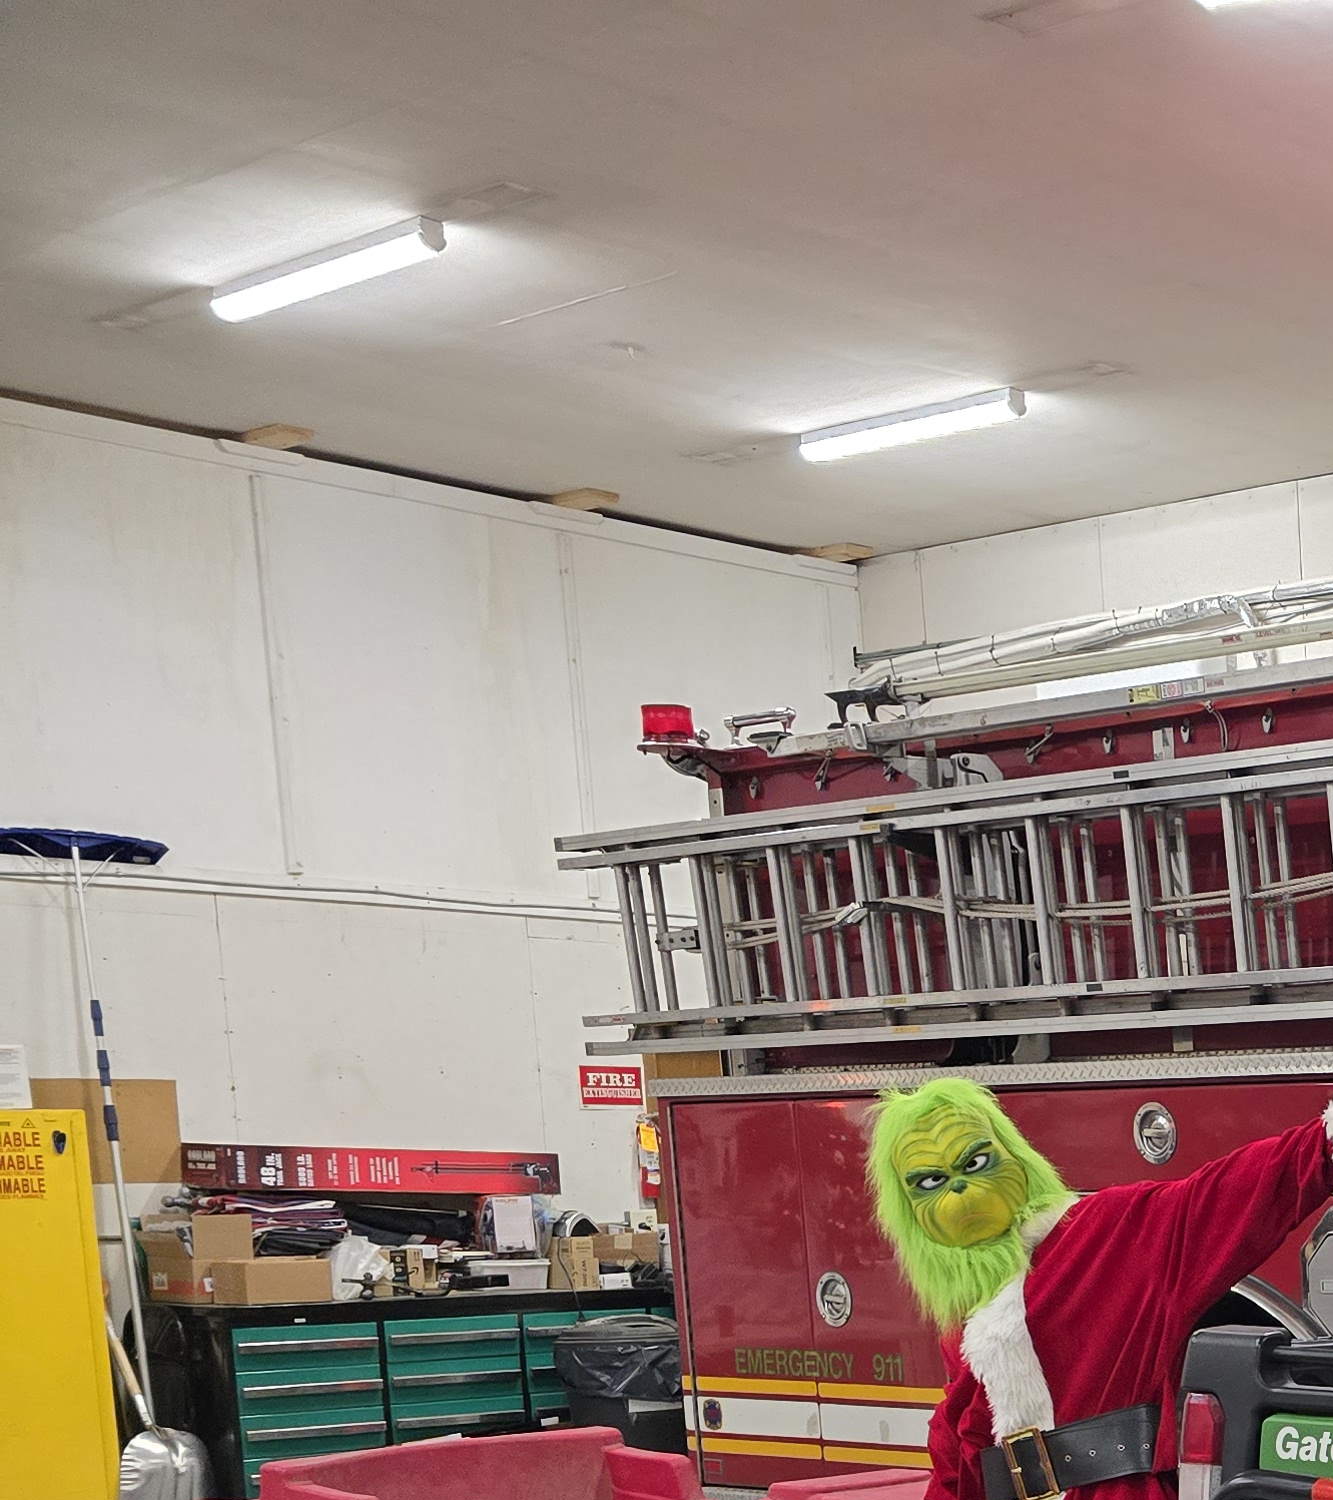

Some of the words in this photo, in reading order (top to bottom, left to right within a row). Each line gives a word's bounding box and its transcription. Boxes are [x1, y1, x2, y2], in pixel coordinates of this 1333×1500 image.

[586, 1072, 636, 1087] FIRE
[582, 1086, 642, 1099] EXTINGUISHER
[0, 1131, 41, 1148] ABLE
[260, 1166, 277, 1187] 48
[0, 1177, 47, 1194] MABLE
[735, 1347, 854, 1379] EMERGENCY
[872, 1354, 904, 1382] 911
